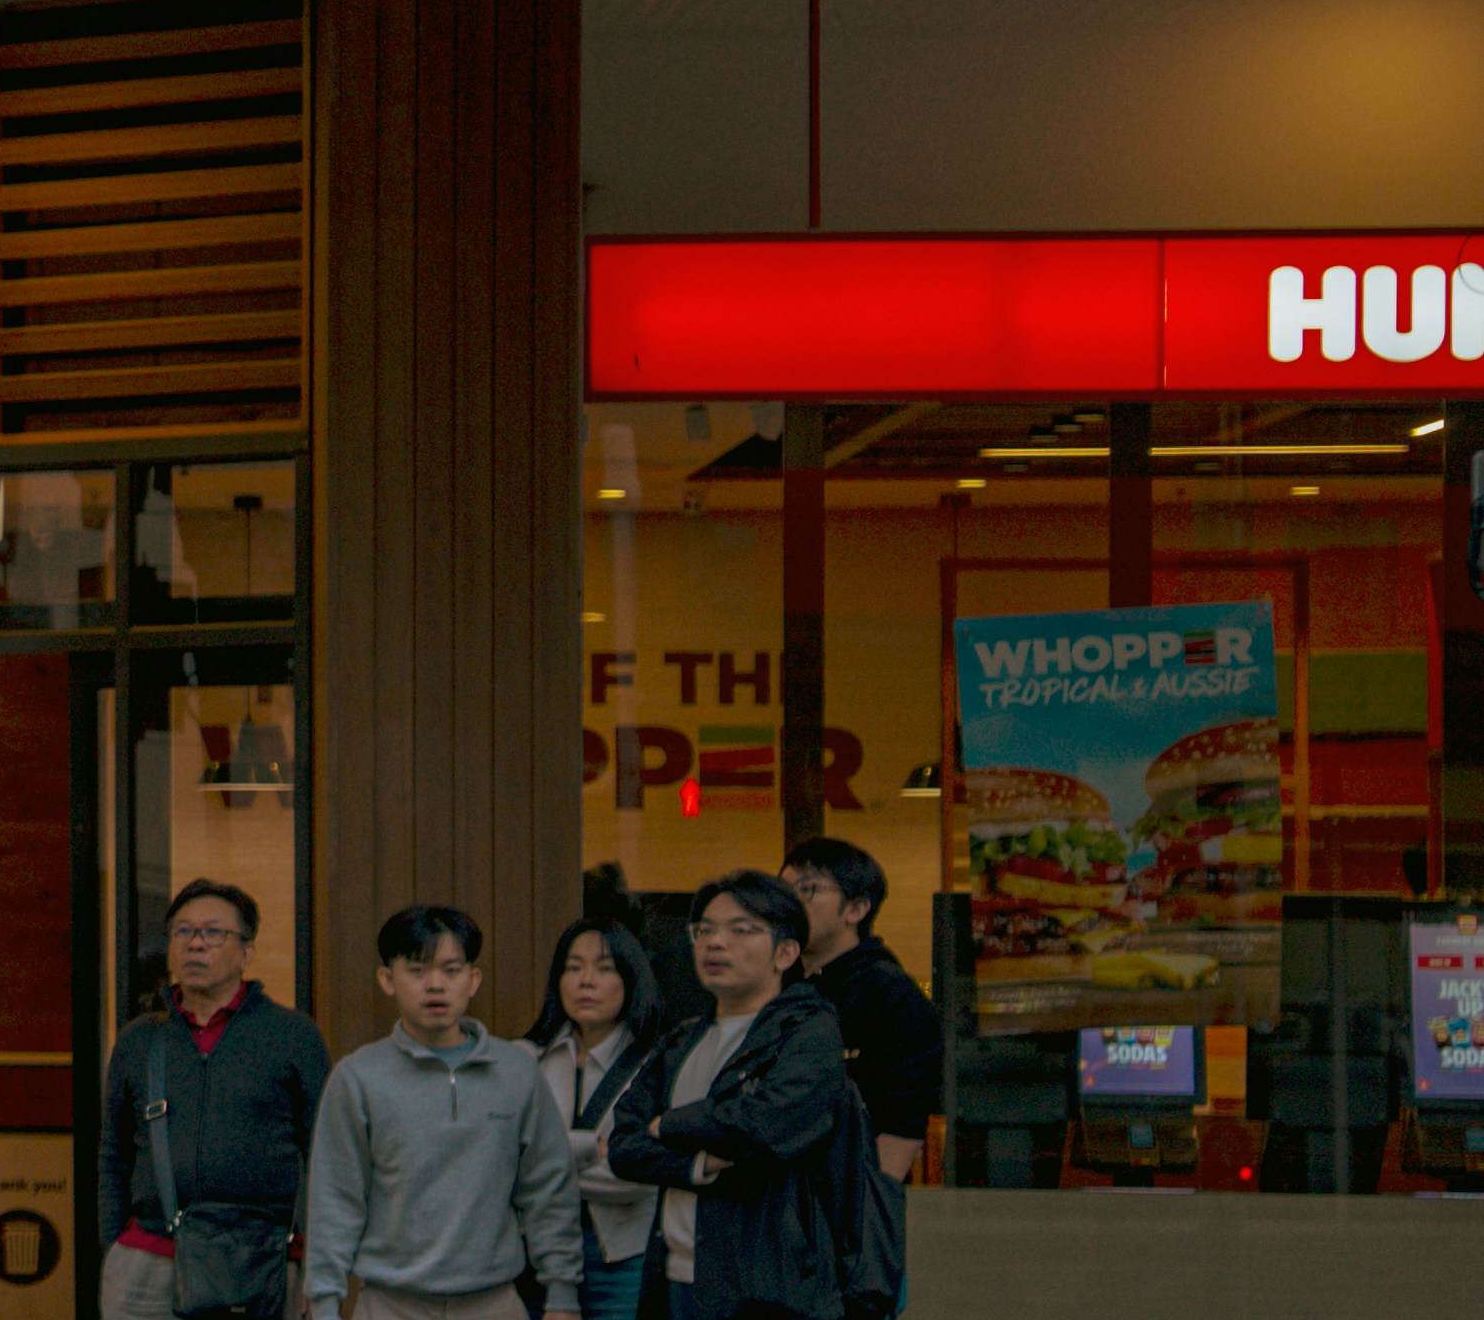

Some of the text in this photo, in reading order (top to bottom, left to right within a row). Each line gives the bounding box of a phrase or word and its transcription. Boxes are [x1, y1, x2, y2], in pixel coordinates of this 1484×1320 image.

[590, 652, 786, 705] F TH
[978, 674, 1127, 710] TROPICAL
[1150, 665, 1261, 700] AUSSIE
[1440, 978, 1484, 1001] JACK
[1107, 1041, 1168, 1065] SODAS
[1440, 1047, 1484, 1069] SODA
[32, 1176, 68, 1196] you!
